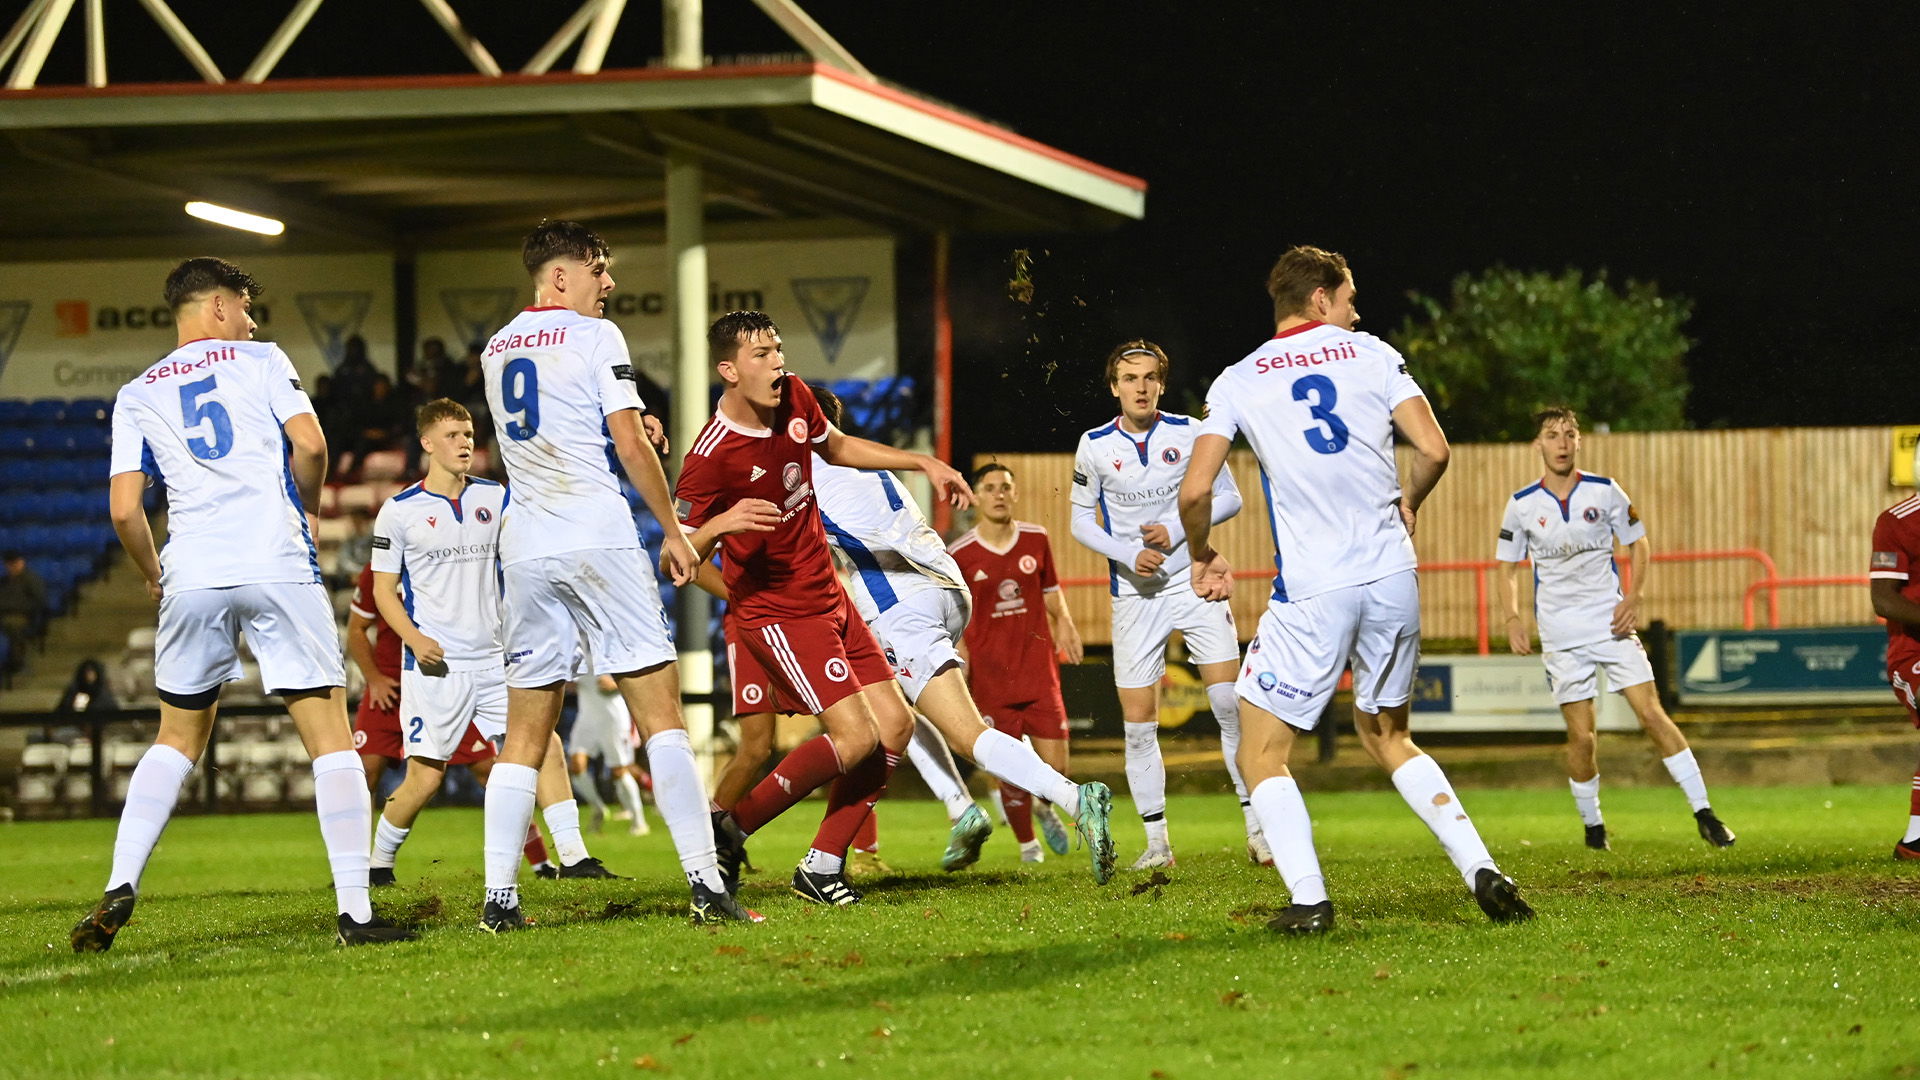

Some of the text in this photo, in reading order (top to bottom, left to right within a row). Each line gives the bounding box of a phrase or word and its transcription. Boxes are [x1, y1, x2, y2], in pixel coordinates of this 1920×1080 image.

[488, 327, 568, 357] Selachii
[1256, 341, 1358, 375] Selachii
[179, 374, 234, 460] 5
[501, 357, 540, 441] 9
[1291, 373, 1349, 455] 3
[409, 716, 424, 743] 2
